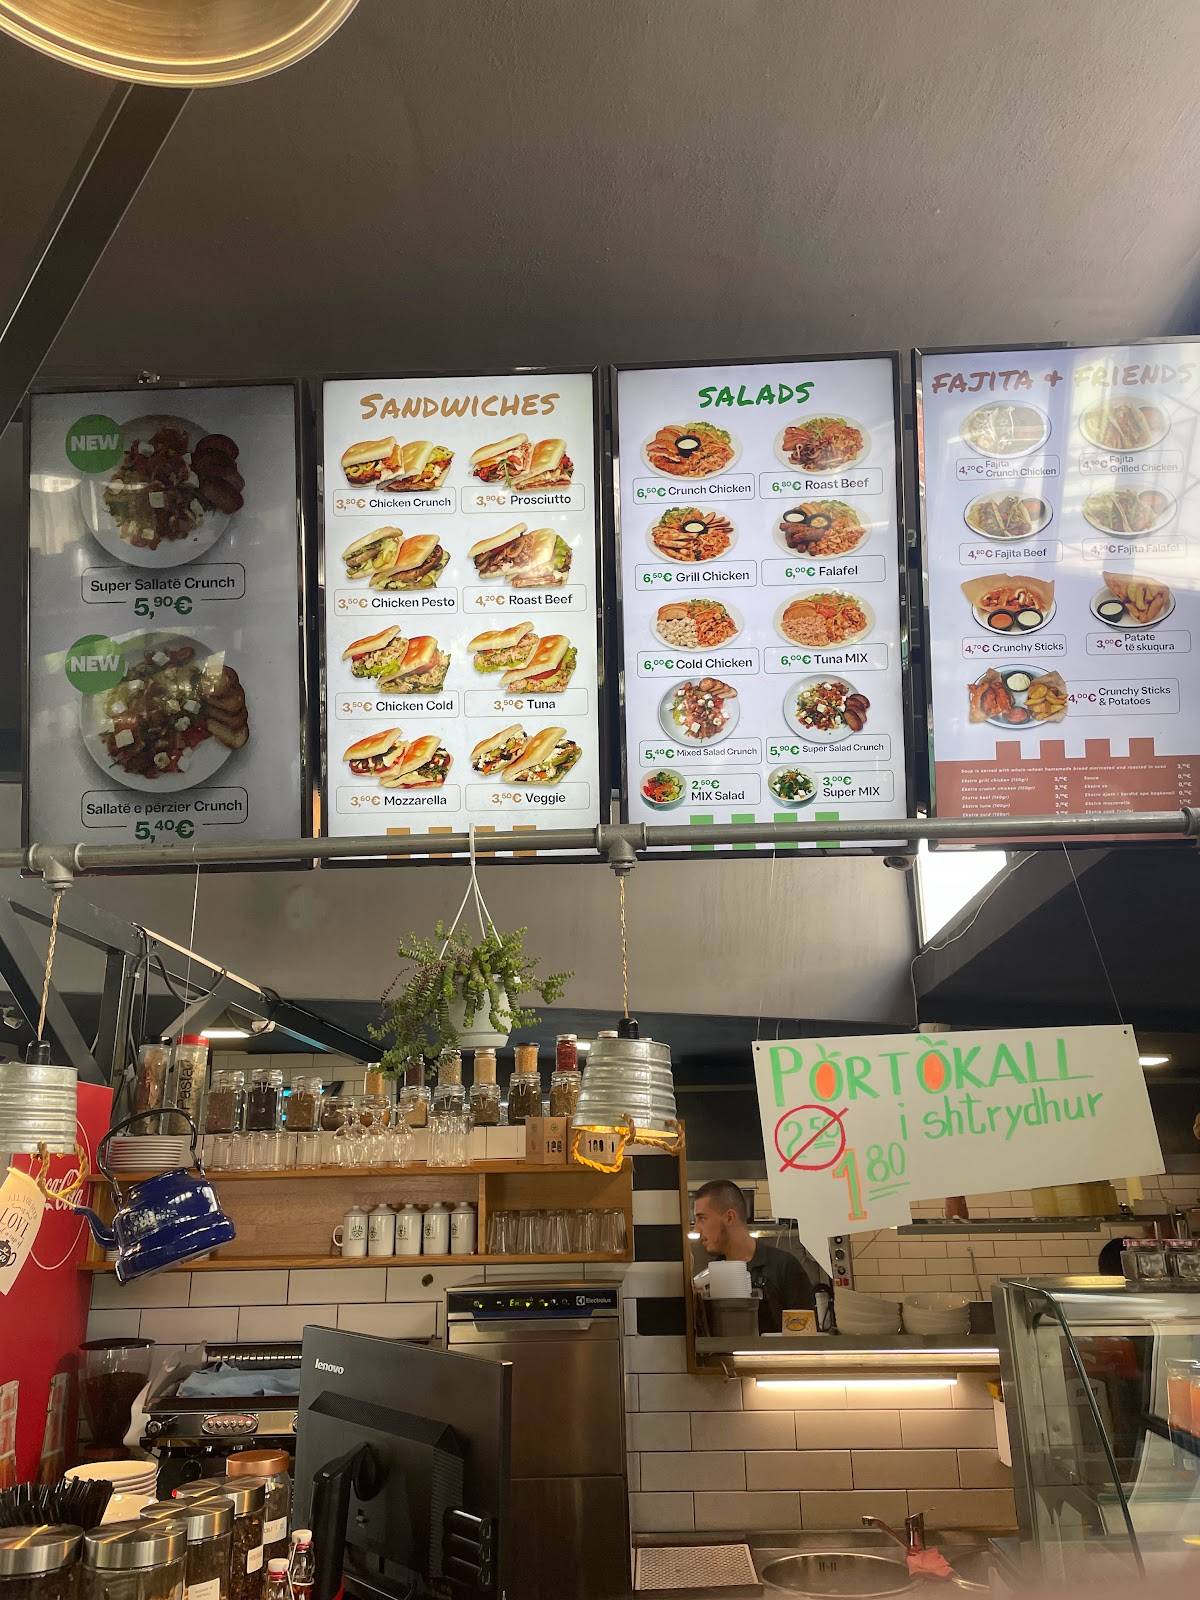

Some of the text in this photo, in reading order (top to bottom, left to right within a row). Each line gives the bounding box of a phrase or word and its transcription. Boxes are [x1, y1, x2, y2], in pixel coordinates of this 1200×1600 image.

[932, 370, 1033, 394] FAJITA
[1075, 363, 1194, 387] FRIENDS
[698, 382, 815, 409] SALADS
[360, 392, 560, 420] SANDWICHES
[70, 434, 119, 451] NEW
[986, 460, 1009, 470] Fajita
[1110, 456, 1134, 465] Fajita
[986, 469, 1018, 477] Crunch
[1020, 467, 1056, 476] Chicken
[1110, 464, 1139, 473] Grilled
[1142, 463, 1178, 471] Chicken
[805, 480, 838, 490] Roast
[841, 478, 869, 488] Beef
[668, 485, 707, 496] Crunch
[709, 484, 751, 495] Chicken
[369, 498, 411, 508] Chicken
[413, 497, 451, 508] Crunch
[510, 494, 571, 505] Prosciutto
[995, 549, 1021, 559] Fajita
[1024, 548, 1047, 557] Beef
[1118, 545, 1144, 556] Fajita
[676, 571, 700, 582] Grill
[704, 570, 749, 581] Chicken
[819, 566, 858, 576] Falafel
[91, 575, 235, 594] Super Sallatë Crunch
[371, 597, 419, 608] Chicken
[422, 597, 455, 607] Pesto
[509, 595, 543, 606] Roast
[546, 594, 572, 605] Beef
[1125, 634, 1155, 642] Patate
[992, 643, 1033, 653] Crunchy
[1035, 642, 1064, 651] Sticks
[1137, 643, 1175, 652] skuqura
[70, 655, 119, 673] NEW
[677, 658, 702, 669] Cold
[705, 657, 752, 668] Chicken
[814, 654, 843, 664] Tuna
[846, 653, 868, 663] MIX
[1099, 686, 1171, 697] Crunchy Sticks
[376, 701, 424, 711] Chicken
[426, 700, 453, 711] Cold
[527, 700, 555, 710] Tuna
[1108, 696, 1151, 705] Potatoes
[677, 748, 701, 757] Mixed
[703, 748, 725, 756] Salad
[727, 747, 757, 756] Crunch
[802, 745, 826, 754] Super
[828, 744, 851, 752] Salad
[853, 743, 884, 752] Crunch
[691, 791, 745, 801] MIX Salad
[823, 787, 880, 798] Super MIX
[384, 795, 446, 806] Mozzarella
[526, 793, 565, 805] Veggie
[86, 799, 243, 817] Sallatë e përzier Crunch
[177, 1067, 193, 1109] Pasta
[899, 1086, 1103, 1140] i shtrydhur
[314, 1358, 344, 1375] lenovo
